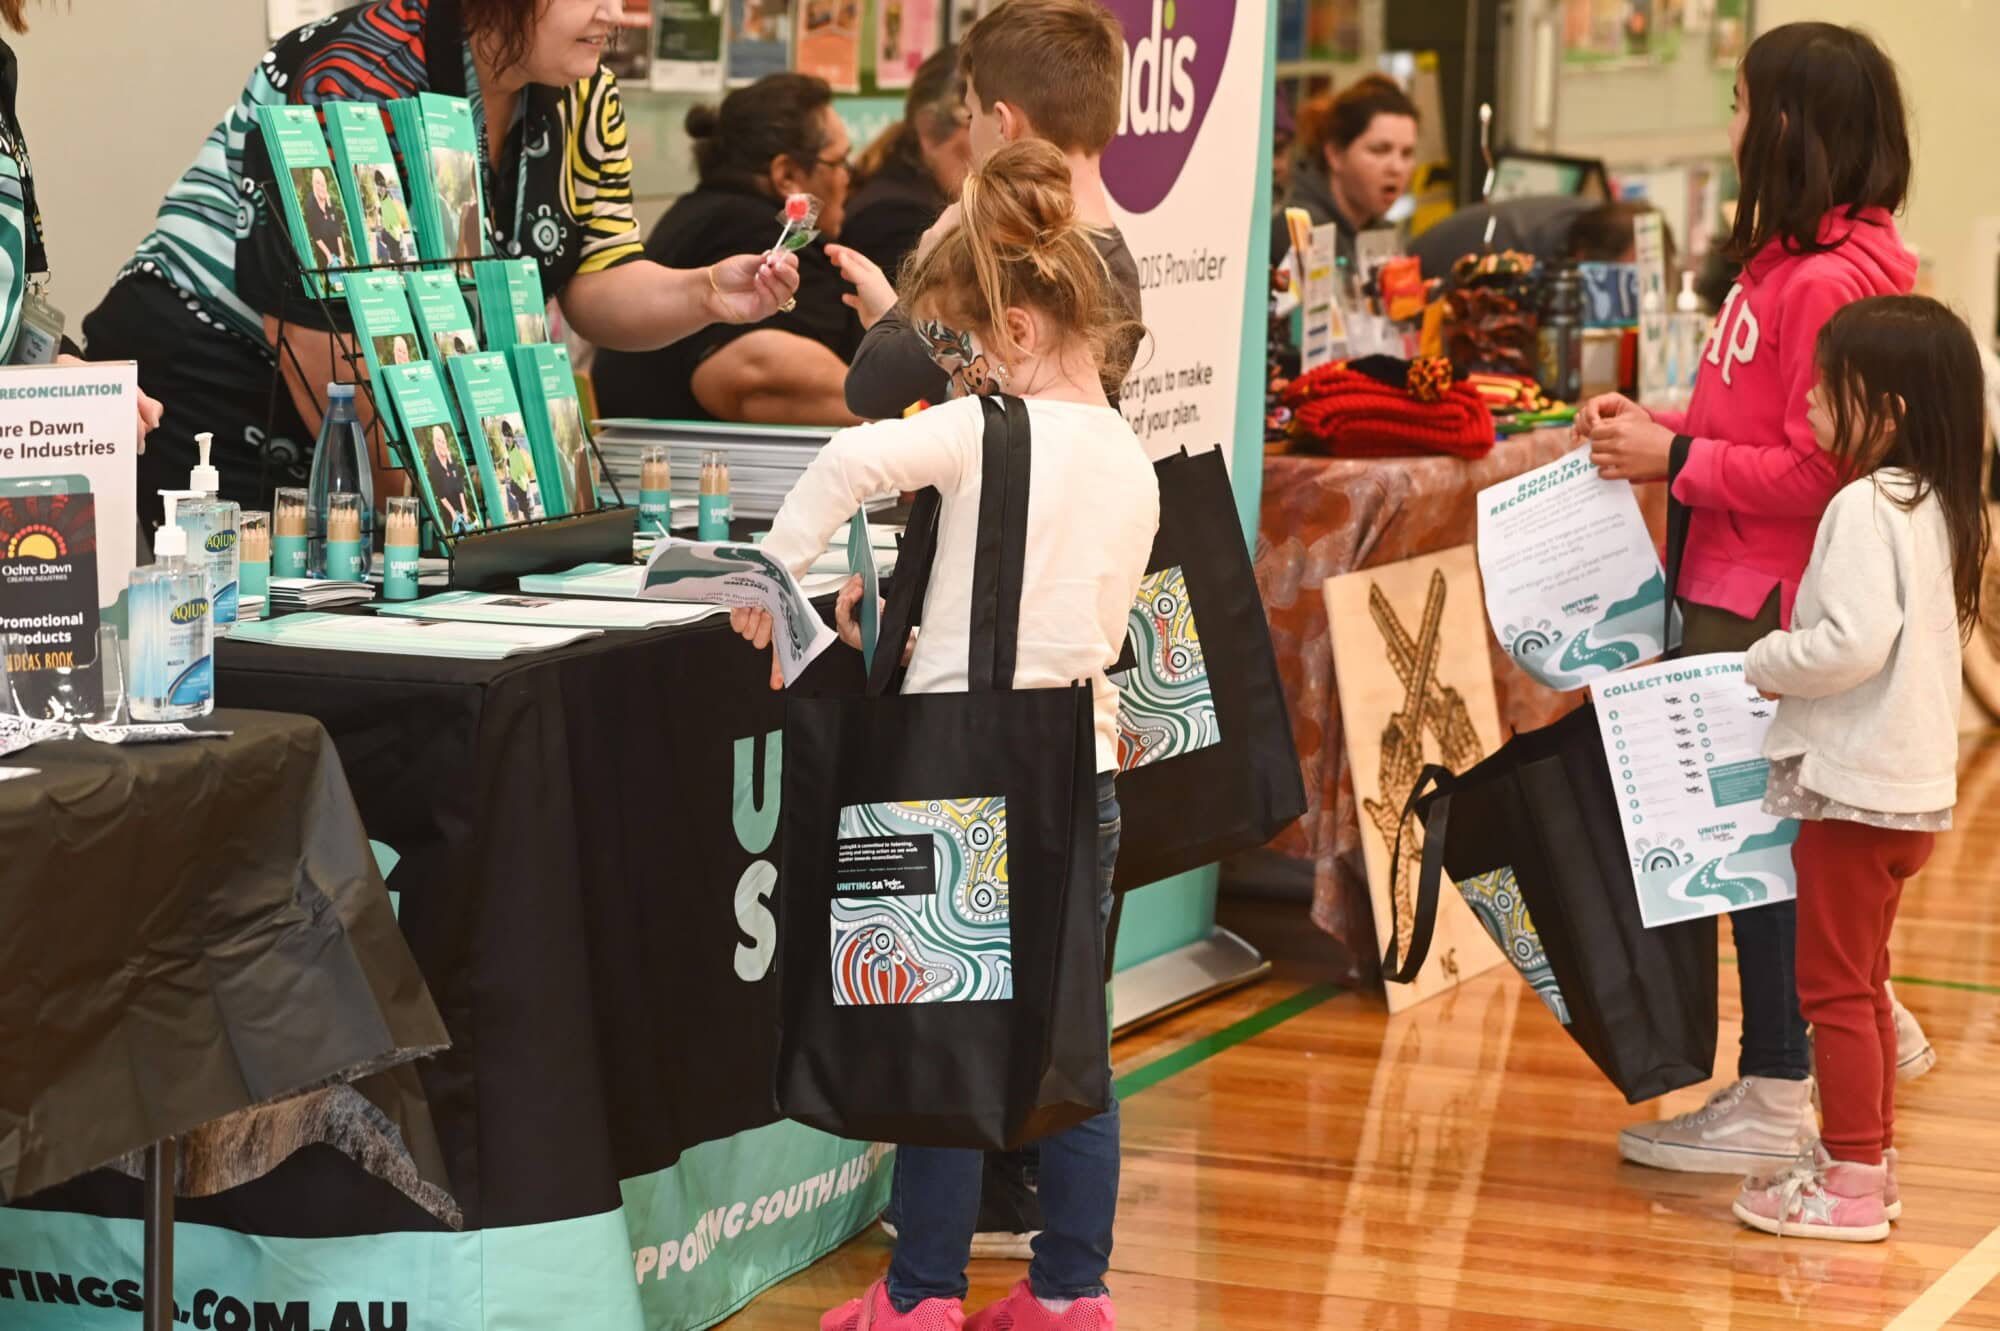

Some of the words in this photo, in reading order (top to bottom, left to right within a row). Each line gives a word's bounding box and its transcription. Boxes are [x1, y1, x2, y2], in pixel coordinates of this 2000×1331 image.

[1138, 254, 1162, 290] DIS
[1166, 247, 1227, 286] Provider
[1142, 376, 1162, 403] you
[1165, 369, 1175, 391] to
[1178, 361, 1213, 389] make
[29, 420, 85, 436] Dawn
[1132, 408, 1146, 435] of
[1146, 409, 1171, 439] your
[20, 439, 116, 459] Industries
[1518, 470, 1559, 493] ROAD
[1562, 458, 1581, 473] TO
[206, 534, 237, 549] AQIUM
[2, 564, 38, 577] Ochre
[39, 563, 73, 575] Dawn
[172, 602, 209, 622] AQIUM
[9, 631, 72, 645] Products
[45, 650, 75, 669] BOOK
[1603, 676, 1662, 698] COLLECT
[1665, 668, 1703, 684] YOUR
[836, 882, 871, 891] UNITING
[871, 881, 883, 890] SA
[745, 1167, 837, 1232] SOUTH
